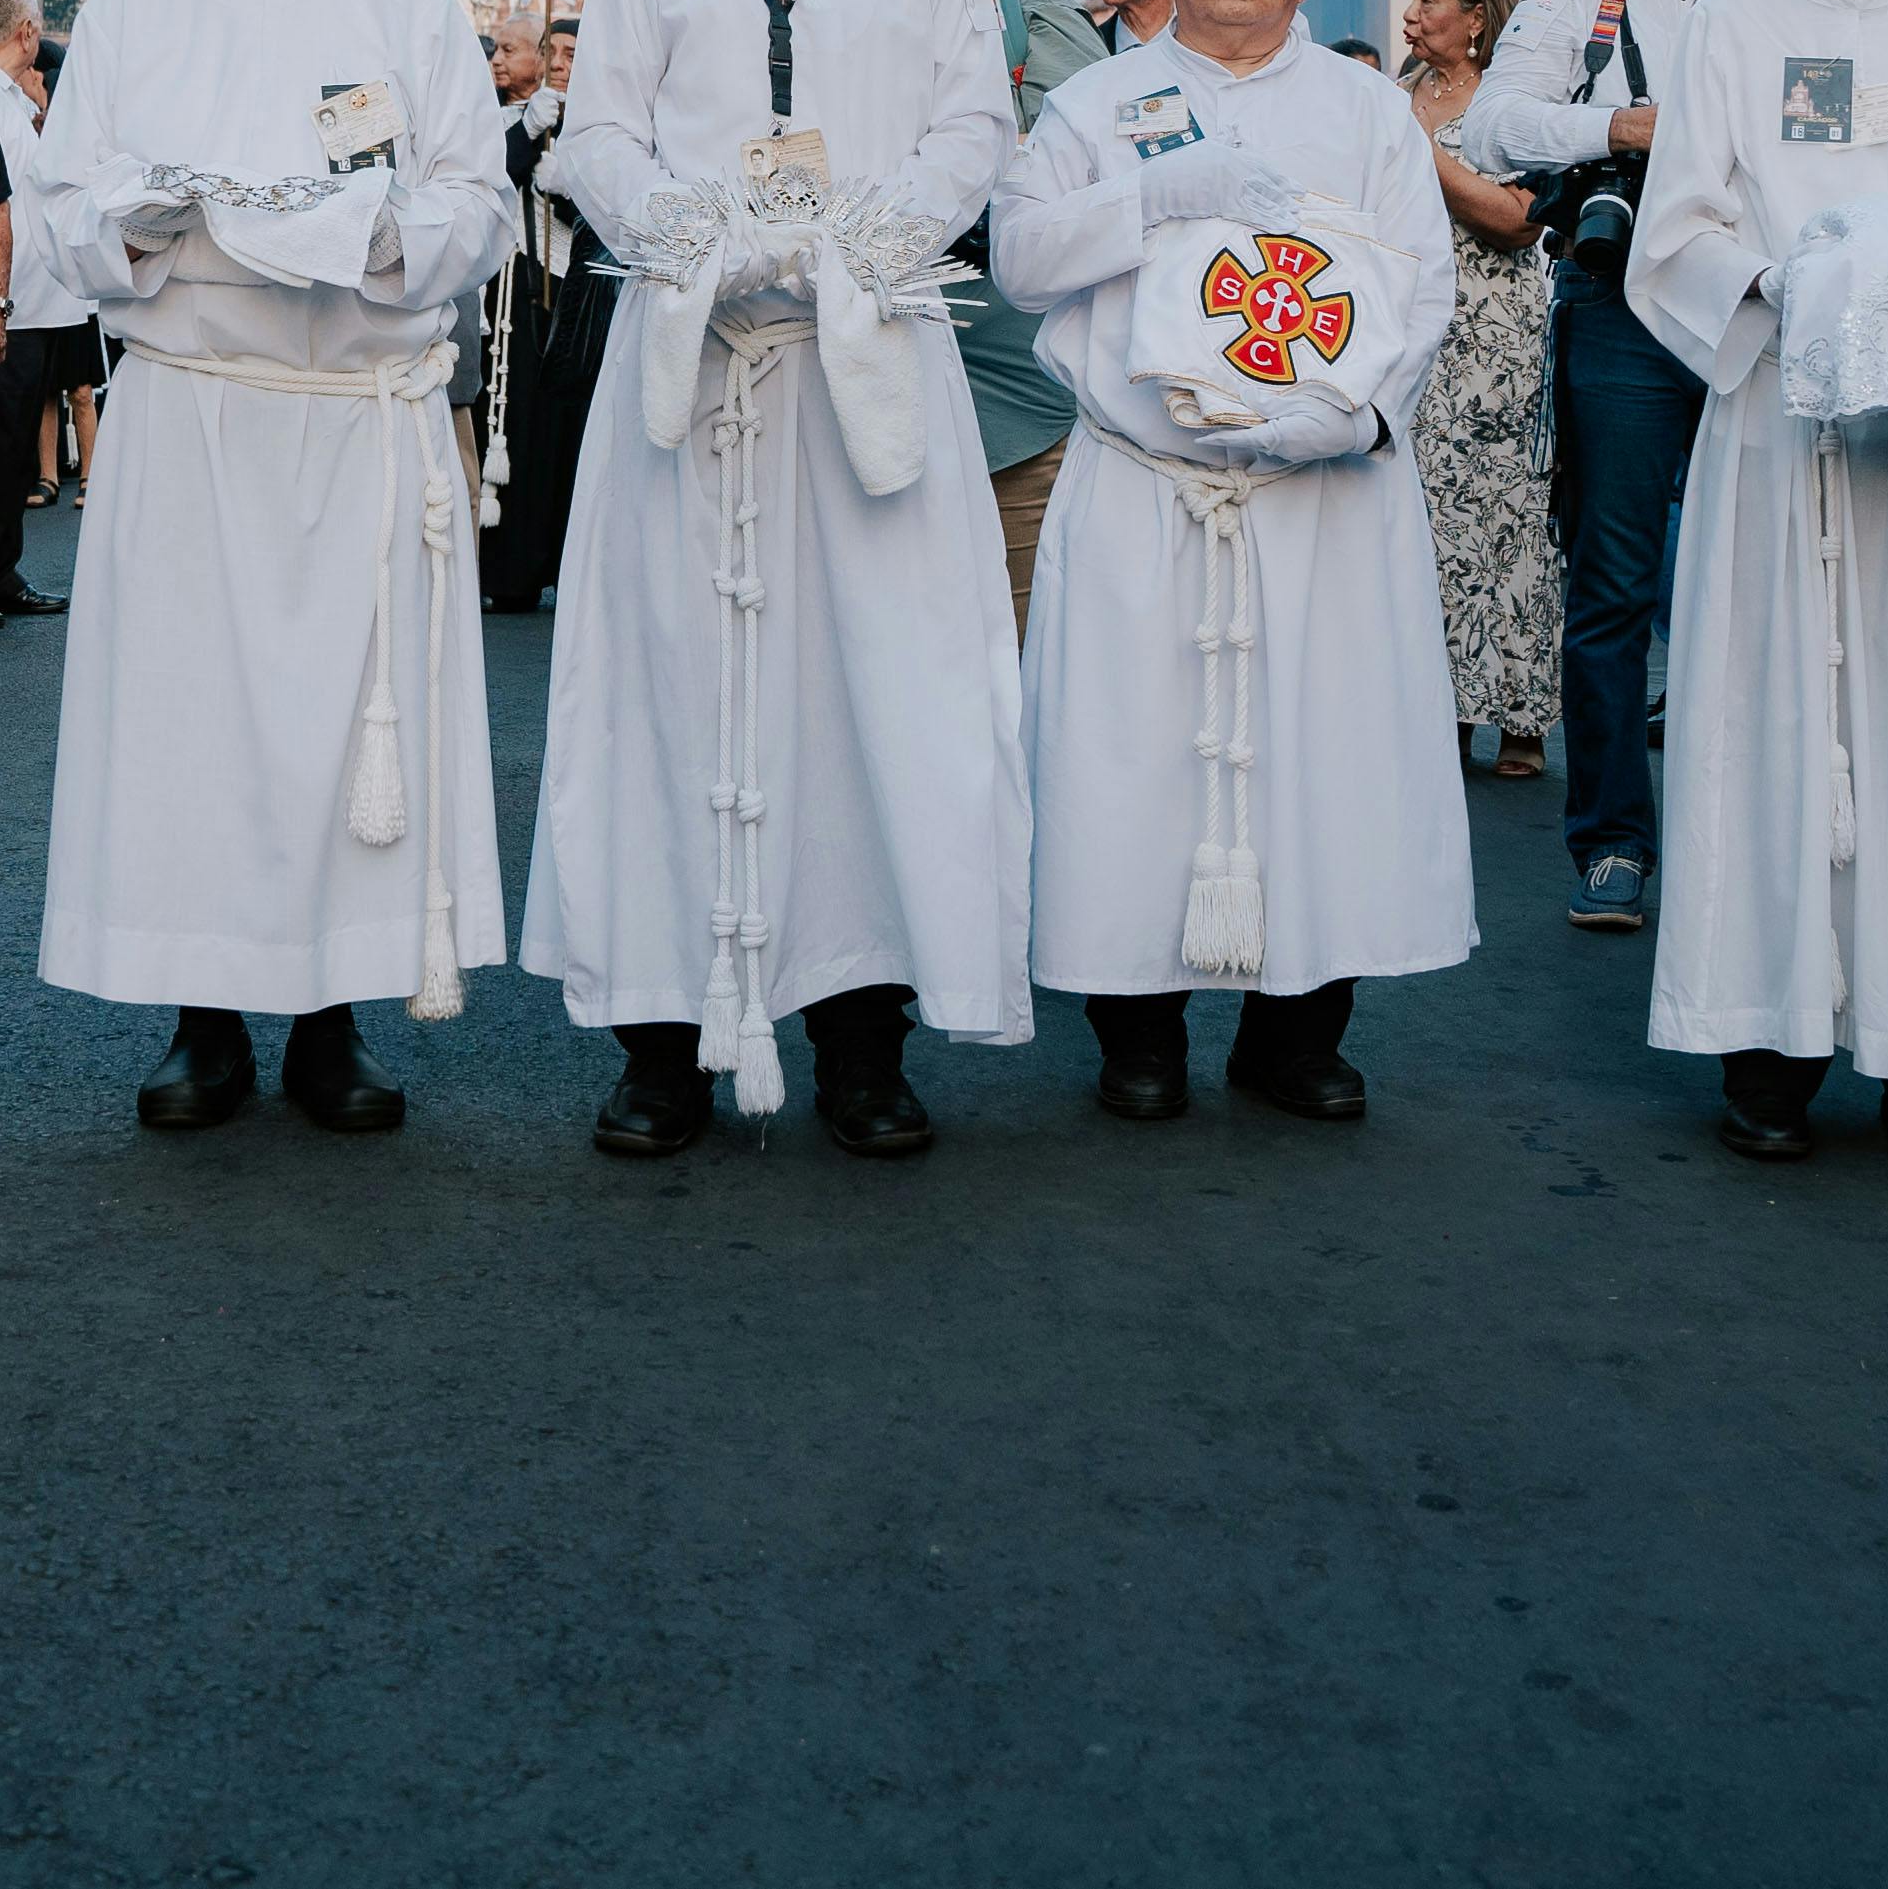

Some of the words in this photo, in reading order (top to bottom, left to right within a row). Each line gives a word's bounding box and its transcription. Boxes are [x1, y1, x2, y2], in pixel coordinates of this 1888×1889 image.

[1277, 246, 1305, 274] H
[1217, 277, 1243, 300] S
[1314, 310, 1338, 338] E
[1249, 340, 1277, 366] C
